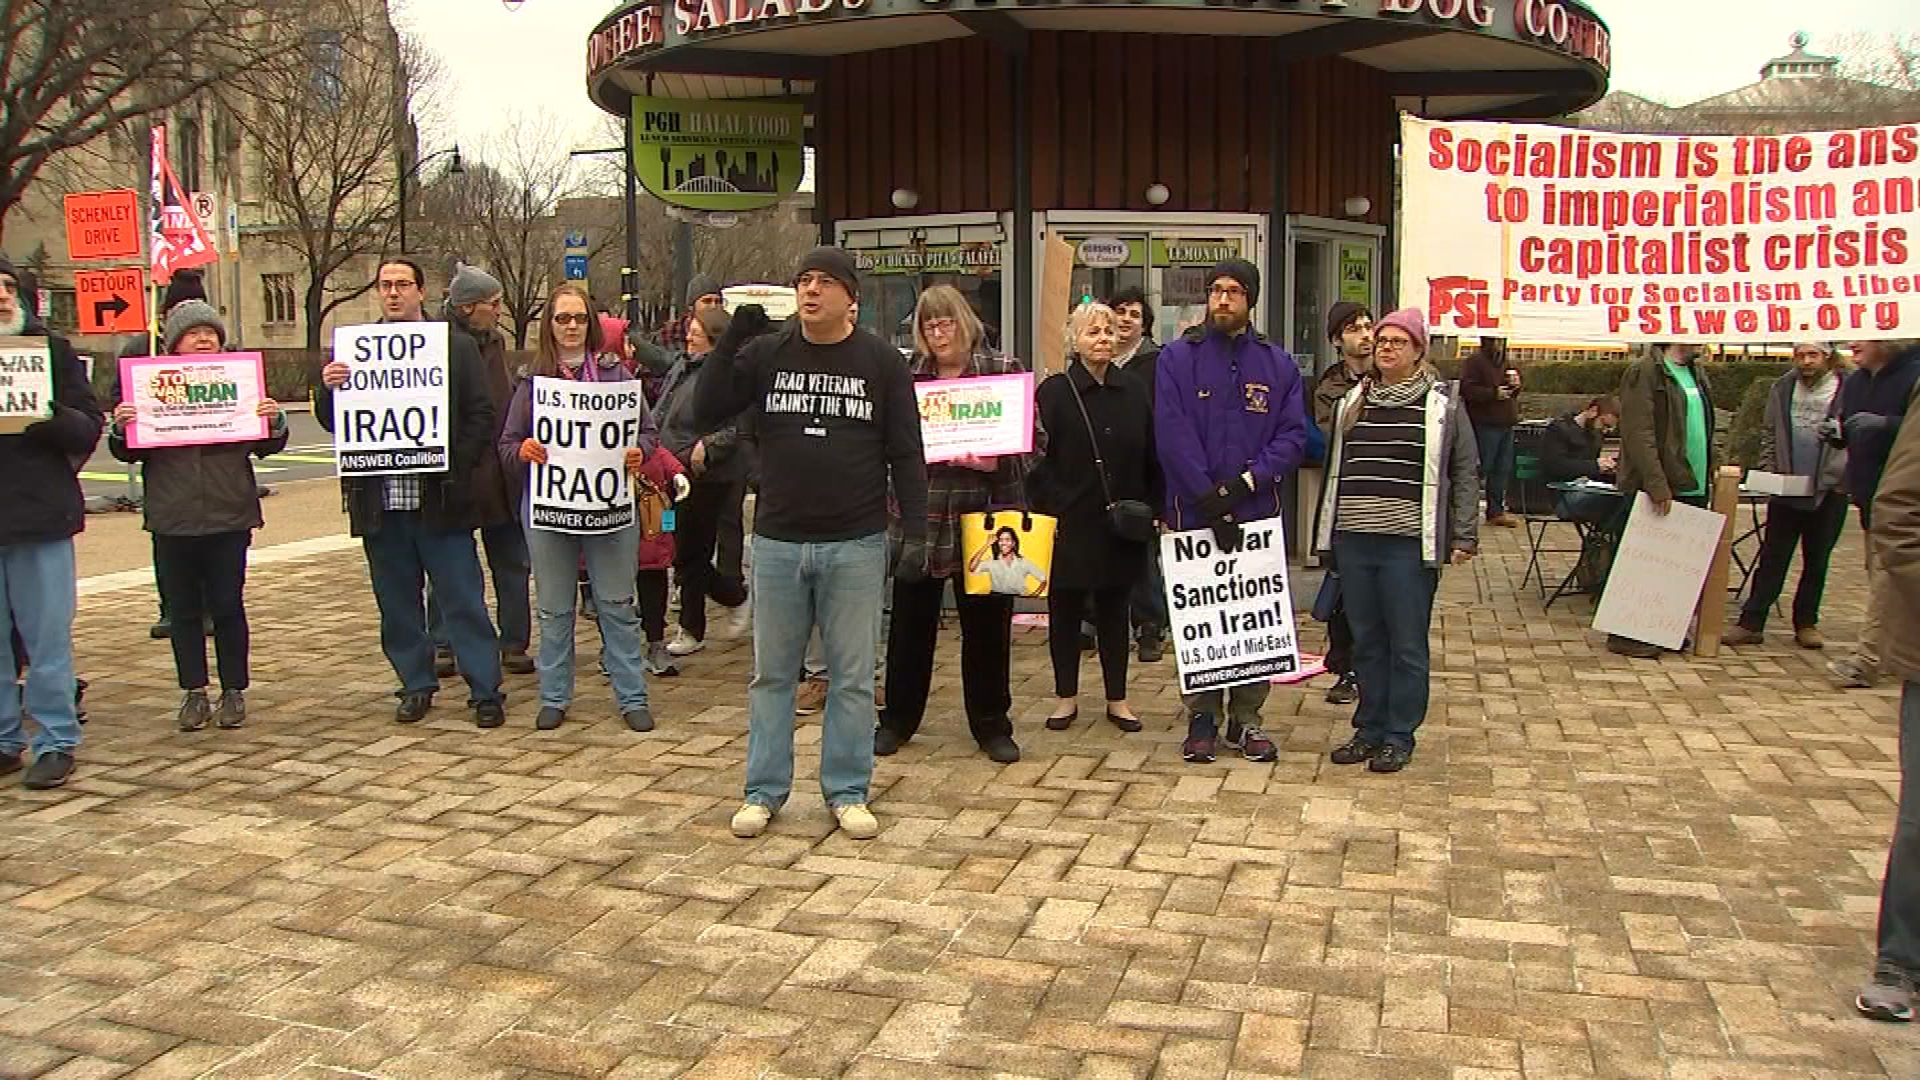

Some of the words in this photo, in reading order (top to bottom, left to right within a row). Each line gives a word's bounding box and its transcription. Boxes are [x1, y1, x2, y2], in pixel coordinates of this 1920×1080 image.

[673, 0, 866, 35] SAL
[645, 111, 680, 132] PGH
[690, 113, 744, 134] HALAL
[749, 115, 790, 136] FOOD
[1428, 127, 1662, 179] Socialism
[1675, 137, 1718, 179] is
[1733, 136, 1812, 176] the
[1827, 126, 1918, 169] ans
[71, 205, 131, 225] SCHENLEY
[1485, 182, 1529, 223] to
[1543, 182, 1836, 231] imperialism
[1853, 176, 1920, 216] an
[85, 228, 121, 245] DRIVE
[1519, 232, 1750, 280] capitalist
[1764, 222, 1908, 271] crisis
[81, 275, 137, 293] DETOUR
[1503, 278, 1581, 306] Party
[1591, 284, 1633, 304] for
[1643, 282, 1802, 304] Socialism
[1813, 280, 1835, 299] &
[1429, 281, 1499, 328] PSL
[1608, 301, 1899, 334] PSLweb.org
[355, 333, 426, 362] STOP
[187, 382, 238, 404] IRAN
[774, 371, 806, 392] IRAQ
[808, 373, 867, 397] VETERANS
[0, 391, 37, 412] AN
[537, 387, 566, 408] U.S.
[570, 391, 638, 411] TROOPS
[765, 392, 816, 413] AGAINST
[820, 395, 842, 417] THE
[845, 397, 873, 421] WAR
[951, 400, 1003, 421] IRAN
[343, 405, 439, 447] IRAQ!
[537, 415, 592, 449] OUT
[600, 418, 638, 450] OF
[340, 453, 394, 469] ANSWER
[395, 451, 446, 466] Coalition
[536, 463, 630, 508] IRAQ!
[533, 508, 583, 525] ANSWER
[585, 510, 632, 527] Coalition
[1173, 535, 1211, 563] No
[1234, 528, 1272, 552] ar
[1214, 558, 1238, 577] or
[1172, 573, 1284, 611] Sanctions
[1183, 621, 1213, 641] on
[1219, 601, 1283, 635] Iran!
[1181, 648, 1205, 665] U.S.
[1208, 644, 1228, 661] Out
[1230, 640, 1242, 657] of
[1244, 633, 1292, 655] Mid-East
